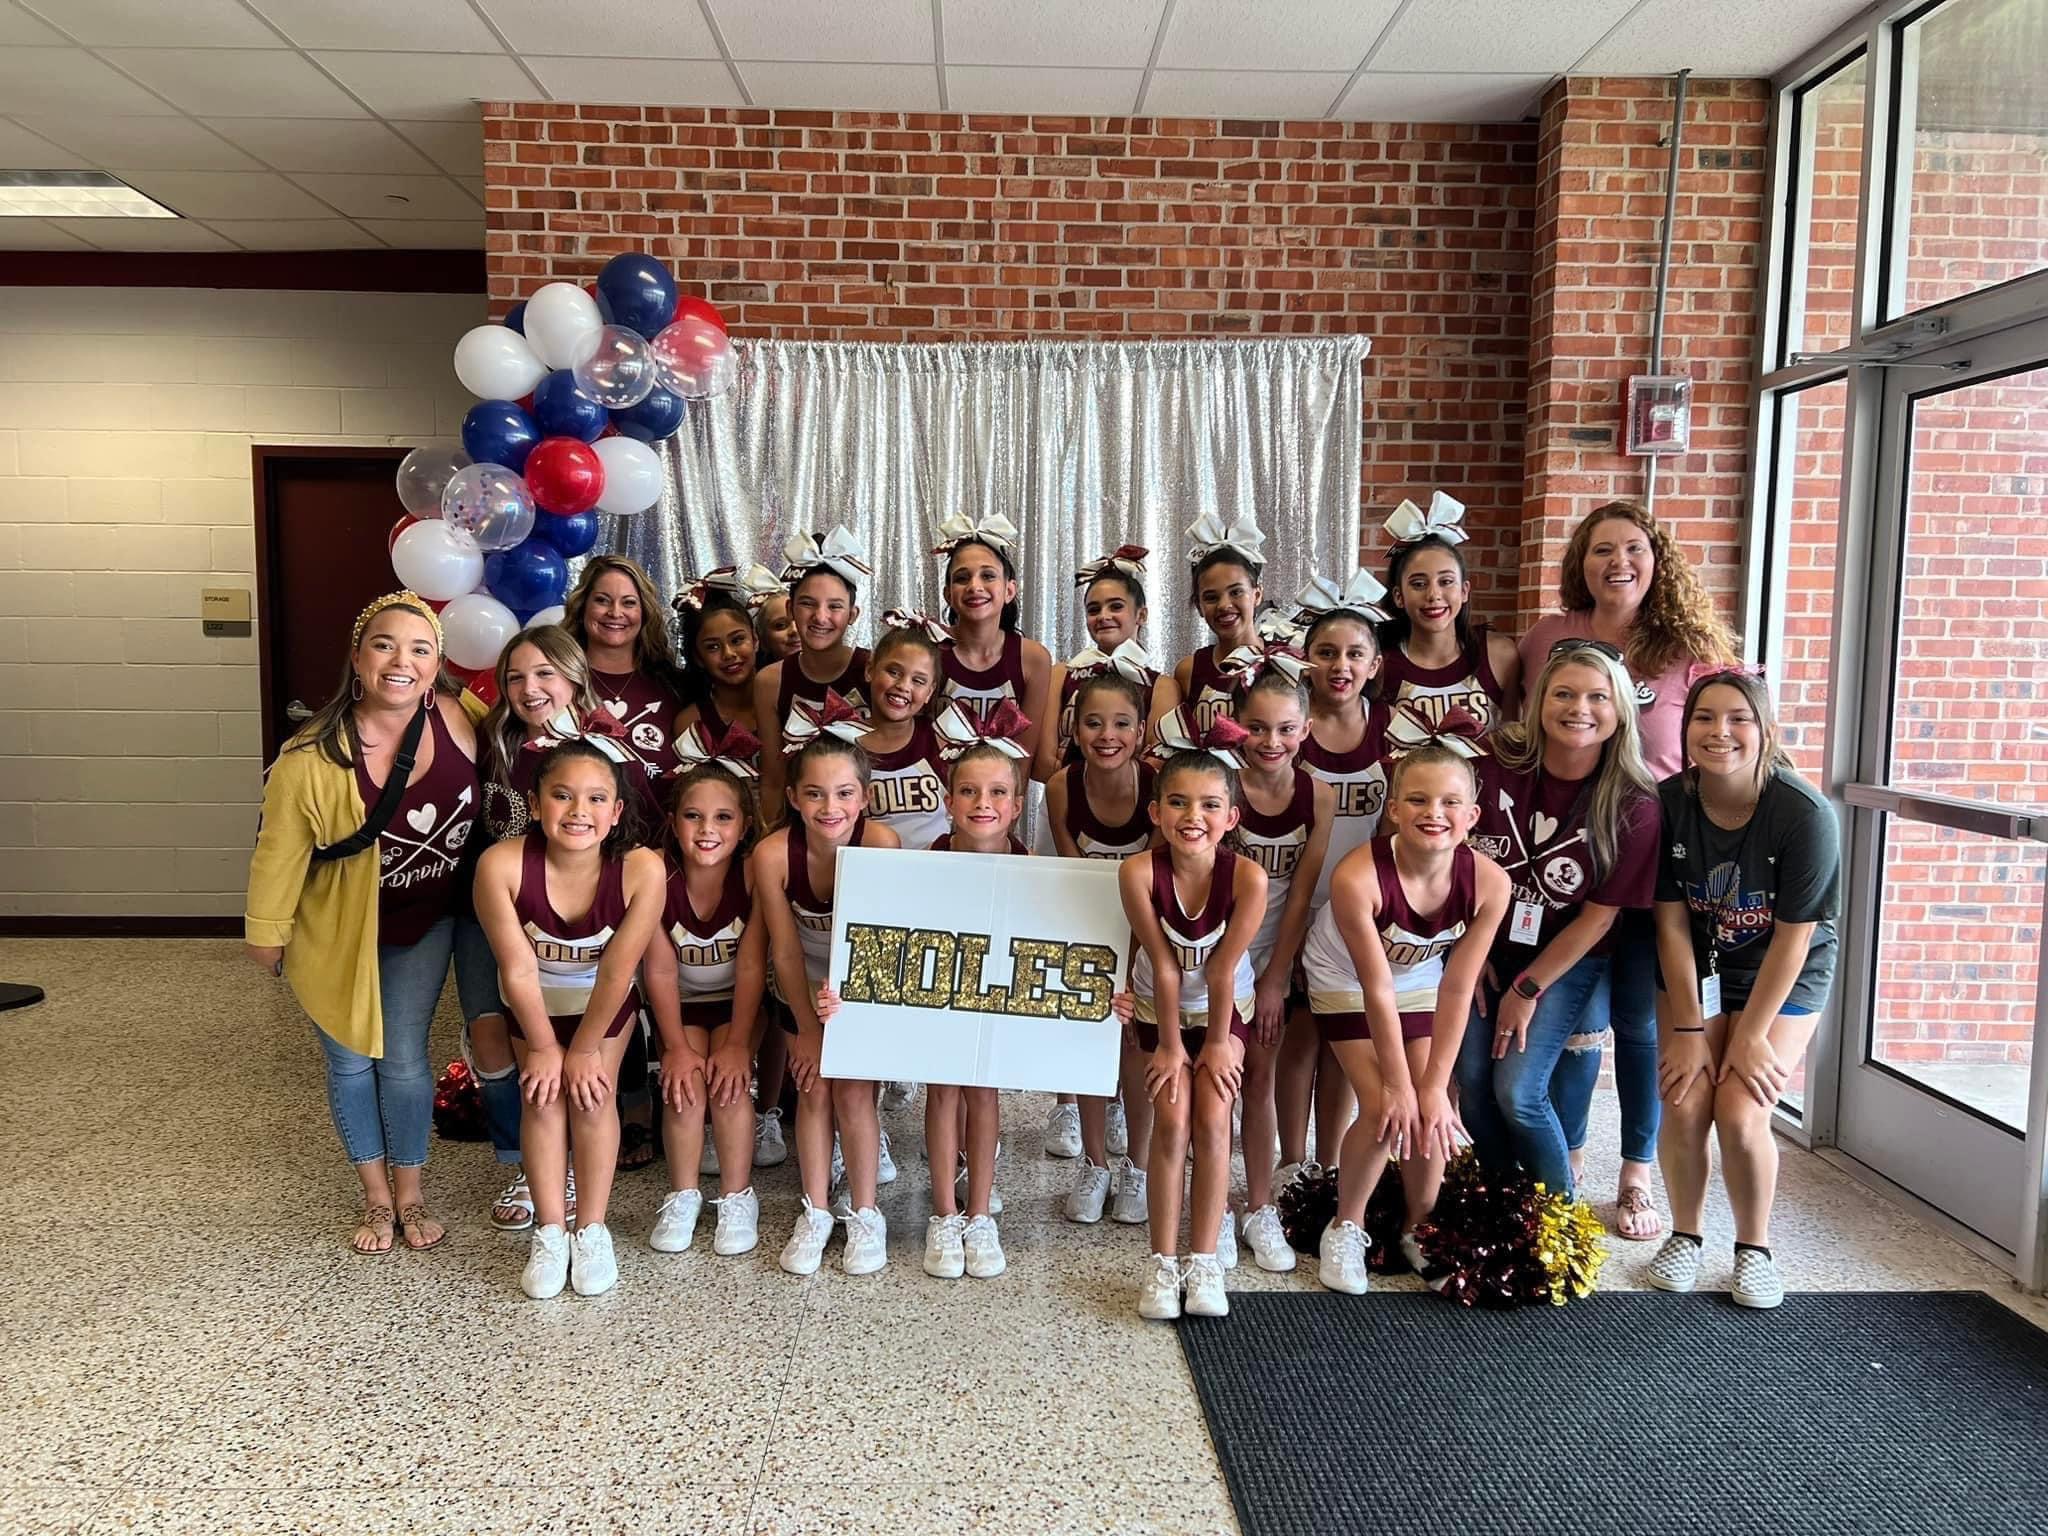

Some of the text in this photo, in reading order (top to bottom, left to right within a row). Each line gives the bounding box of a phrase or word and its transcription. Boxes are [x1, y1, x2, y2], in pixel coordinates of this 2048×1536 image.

[1396, 689, 1490, 727] OLES
[862, 774, 940, 817] OLES
[1330, 780, 1385, 817] LES
[533, 940, 604, 963] OLE
[674, 938, 740, 967] OLE
[839, 922, 1118, 1023] NOLES
